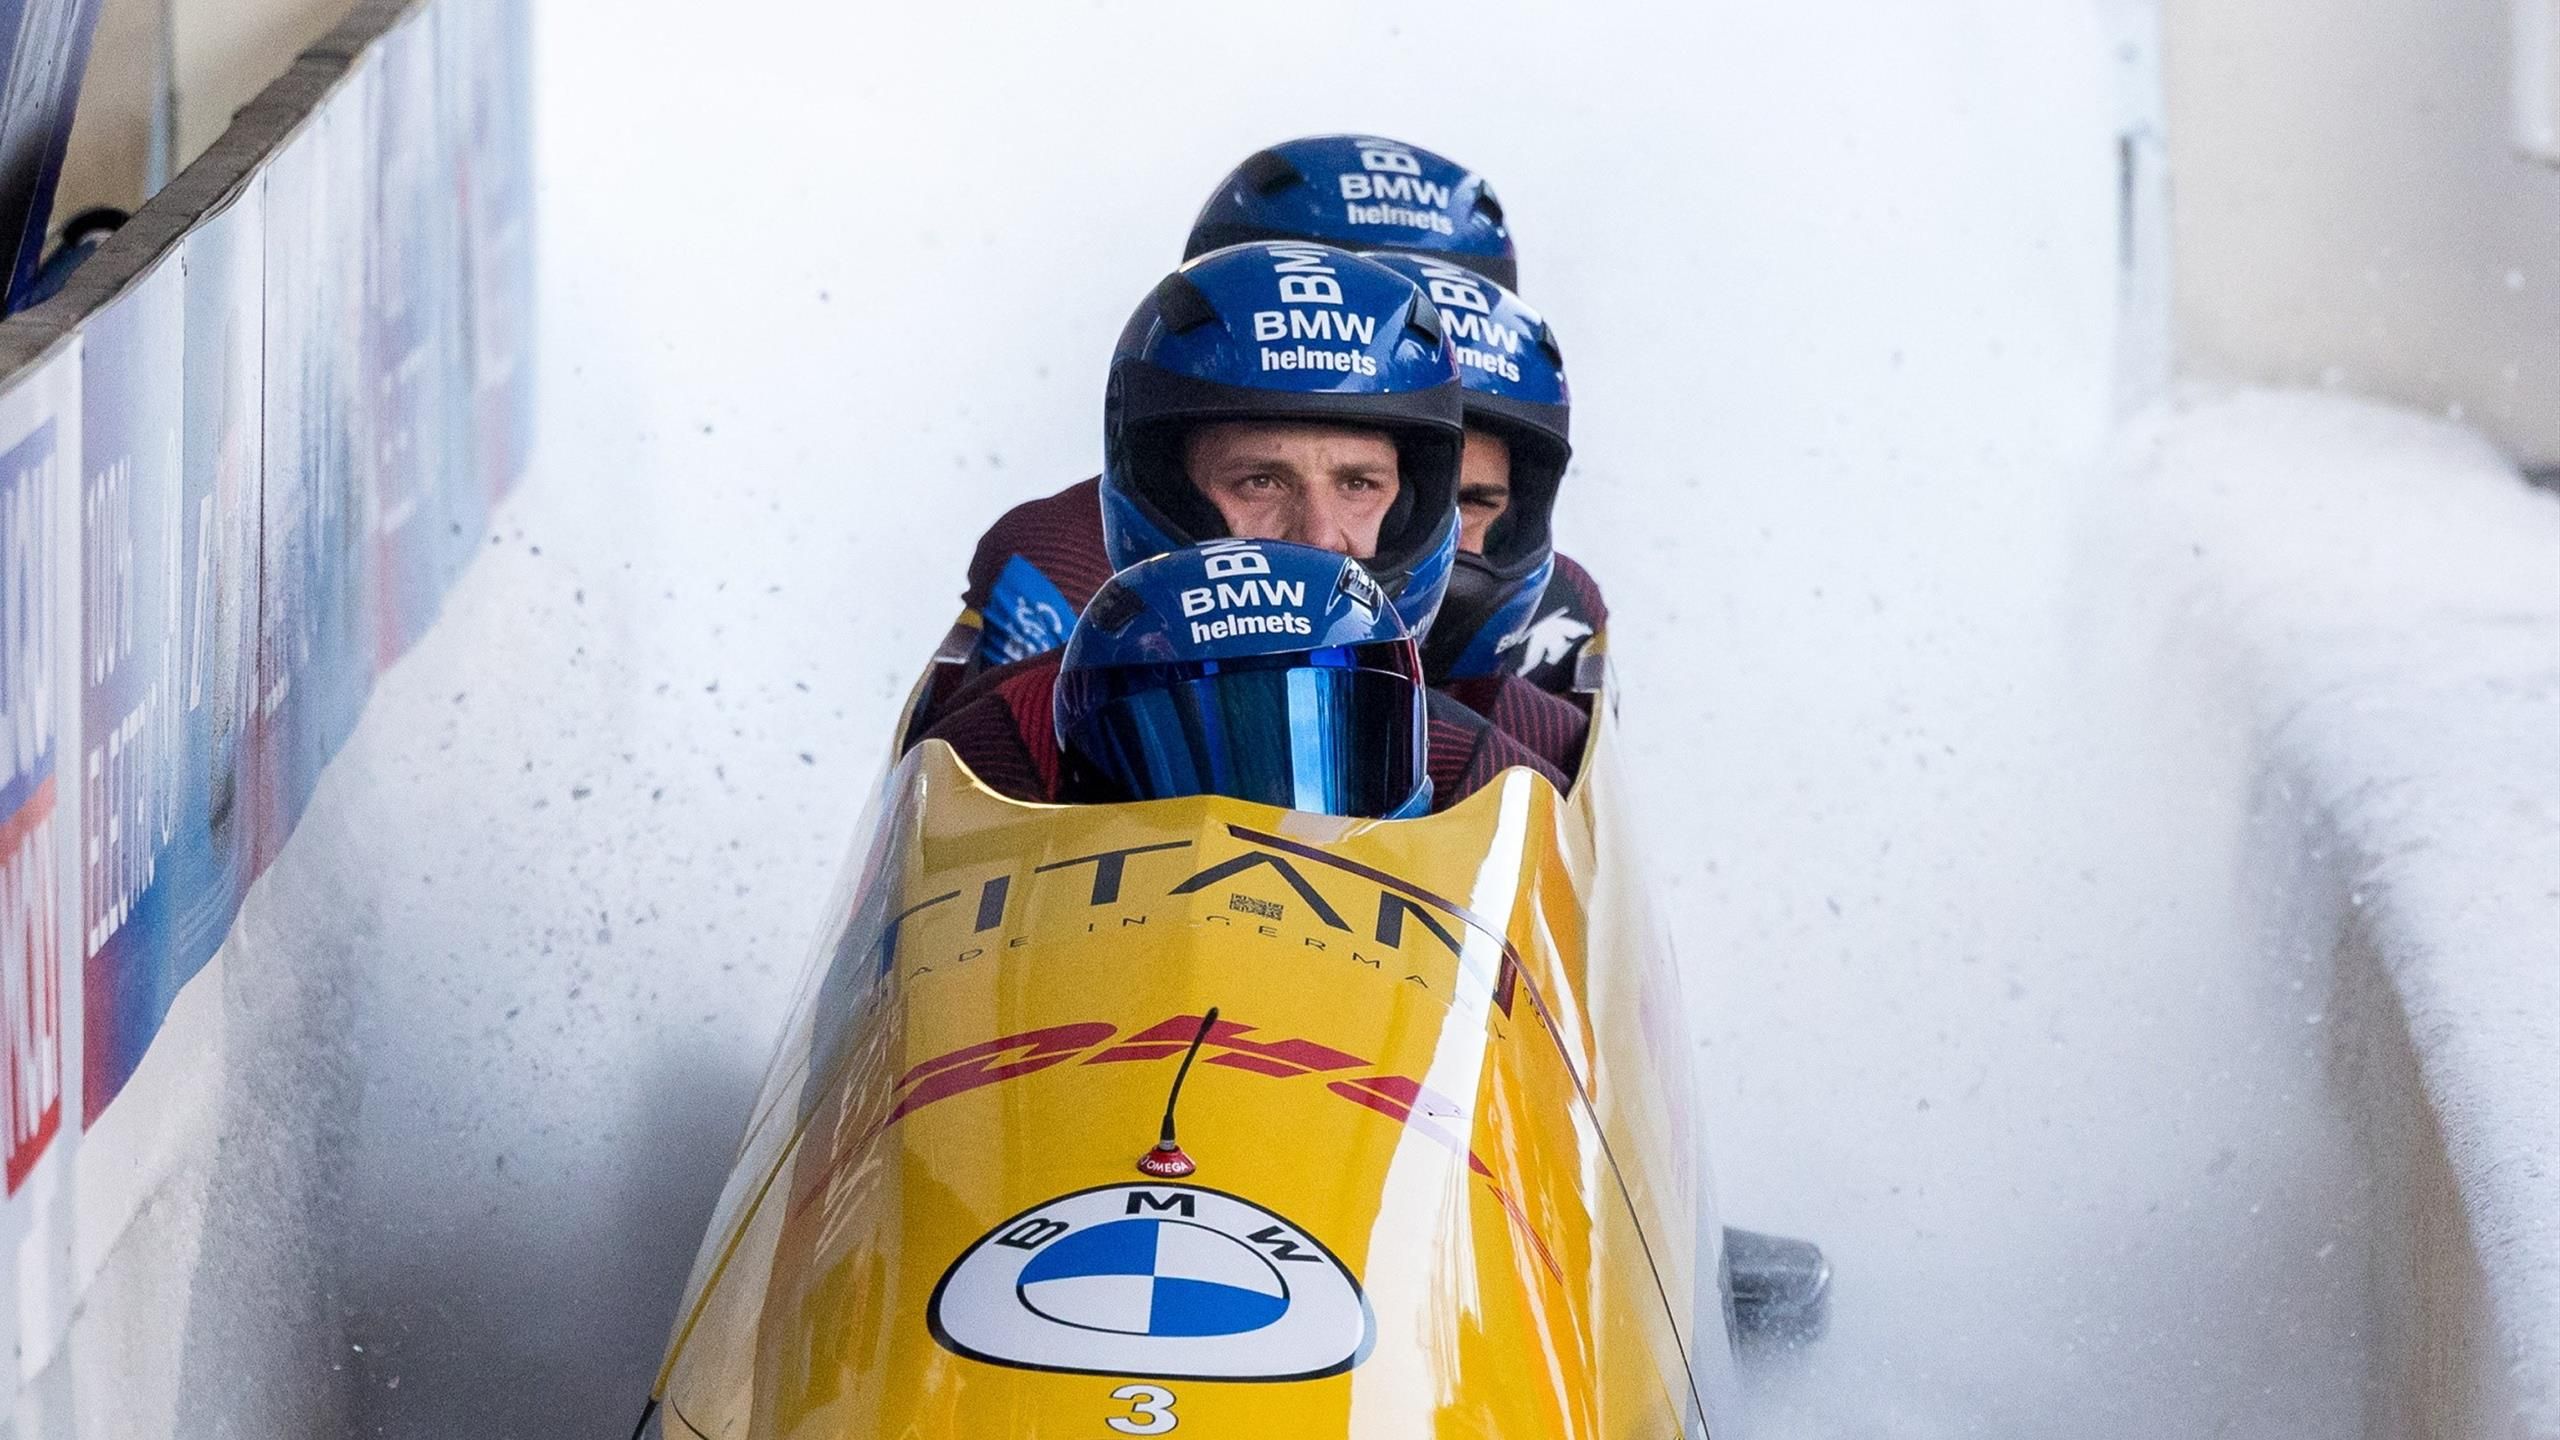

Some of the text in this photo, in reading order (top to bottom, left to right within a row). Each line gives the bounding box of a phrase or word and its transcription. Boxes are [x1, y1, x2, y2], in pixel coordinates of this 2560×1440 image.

[1339, 172, 1450, 209] BMW
[1346, 201, 1454, 236] helmets
[1253, 309, 1376, 345] BMW
[1439, 308, 1518, 355] MW
[1260, 345, 1377, 377] helmets
[1455, 345, 1520, 383] mets
[1181, 579, 1306, 618] BMW
[1190, 611, 1312, 644] helmets
[868, 838, 1519, 1021] TITAN
[1087, 915, 1147, 933] IN
[884, 1014, 1496, 1178] DHL
[1146, 1160, 1189, 1173] OMEGA
[994, 1190, 1324, 1265] BMW
[1105, 1384, 1178, 1436] 3
